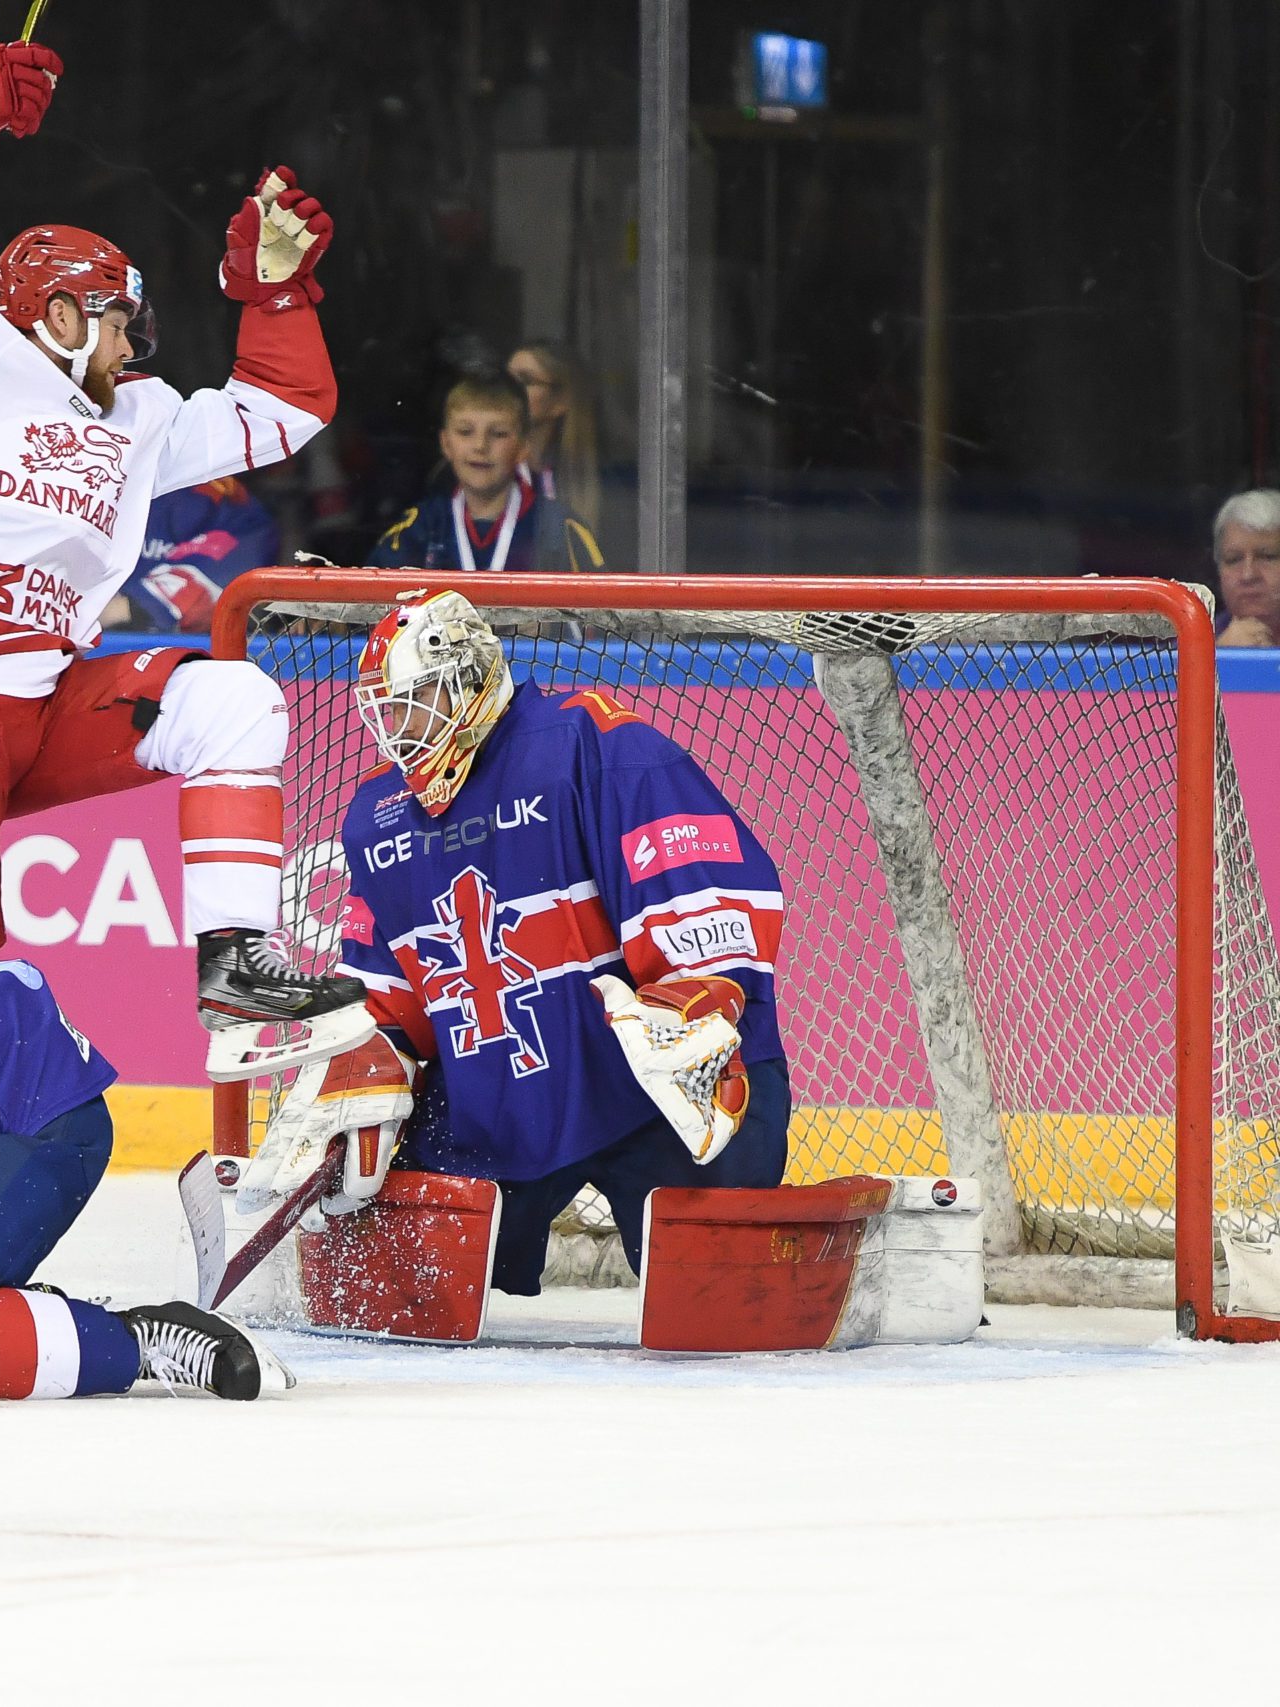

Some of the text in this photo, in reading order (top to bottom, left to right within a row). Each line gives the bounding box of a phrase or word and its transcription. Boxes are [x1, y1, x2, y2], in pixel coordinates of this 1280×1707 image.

[661, 825, 700, 845] SMP
[665, 842, 732, 858] EUROPE
[663, 917, 745, 958] Aspire
